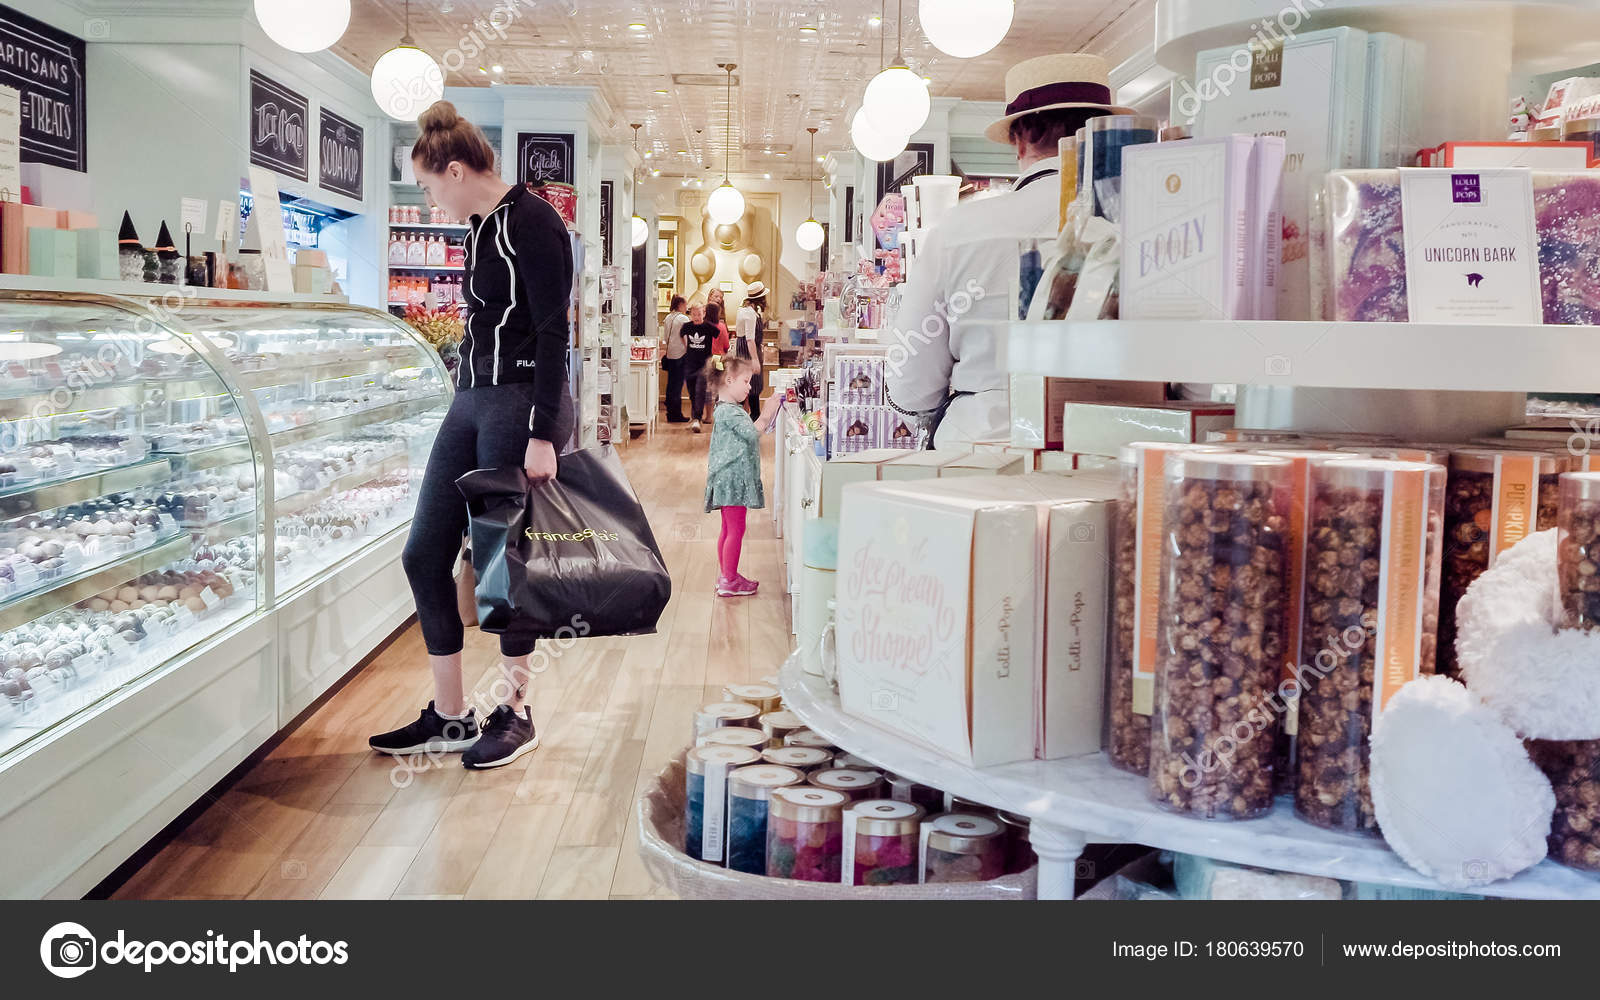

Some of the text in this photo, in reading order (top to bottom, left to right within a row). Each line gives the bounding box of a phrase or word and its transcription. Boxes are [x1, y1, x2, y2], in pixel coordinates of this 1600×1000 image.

[28, 91, 71, 140] TREATS
[322, 135, 359, 184] SODA POP
[1455, 178, 1477, 186] LOLLI
[1456, 191, 1477, 199] POPS
[1140, 214, 1206, 278] BOOZY
[1425, 247, 1517, 262] UNICORN BARK
[998, 596, 1014, 632] Pops
[1070, 591, 1085, 627] Pops
